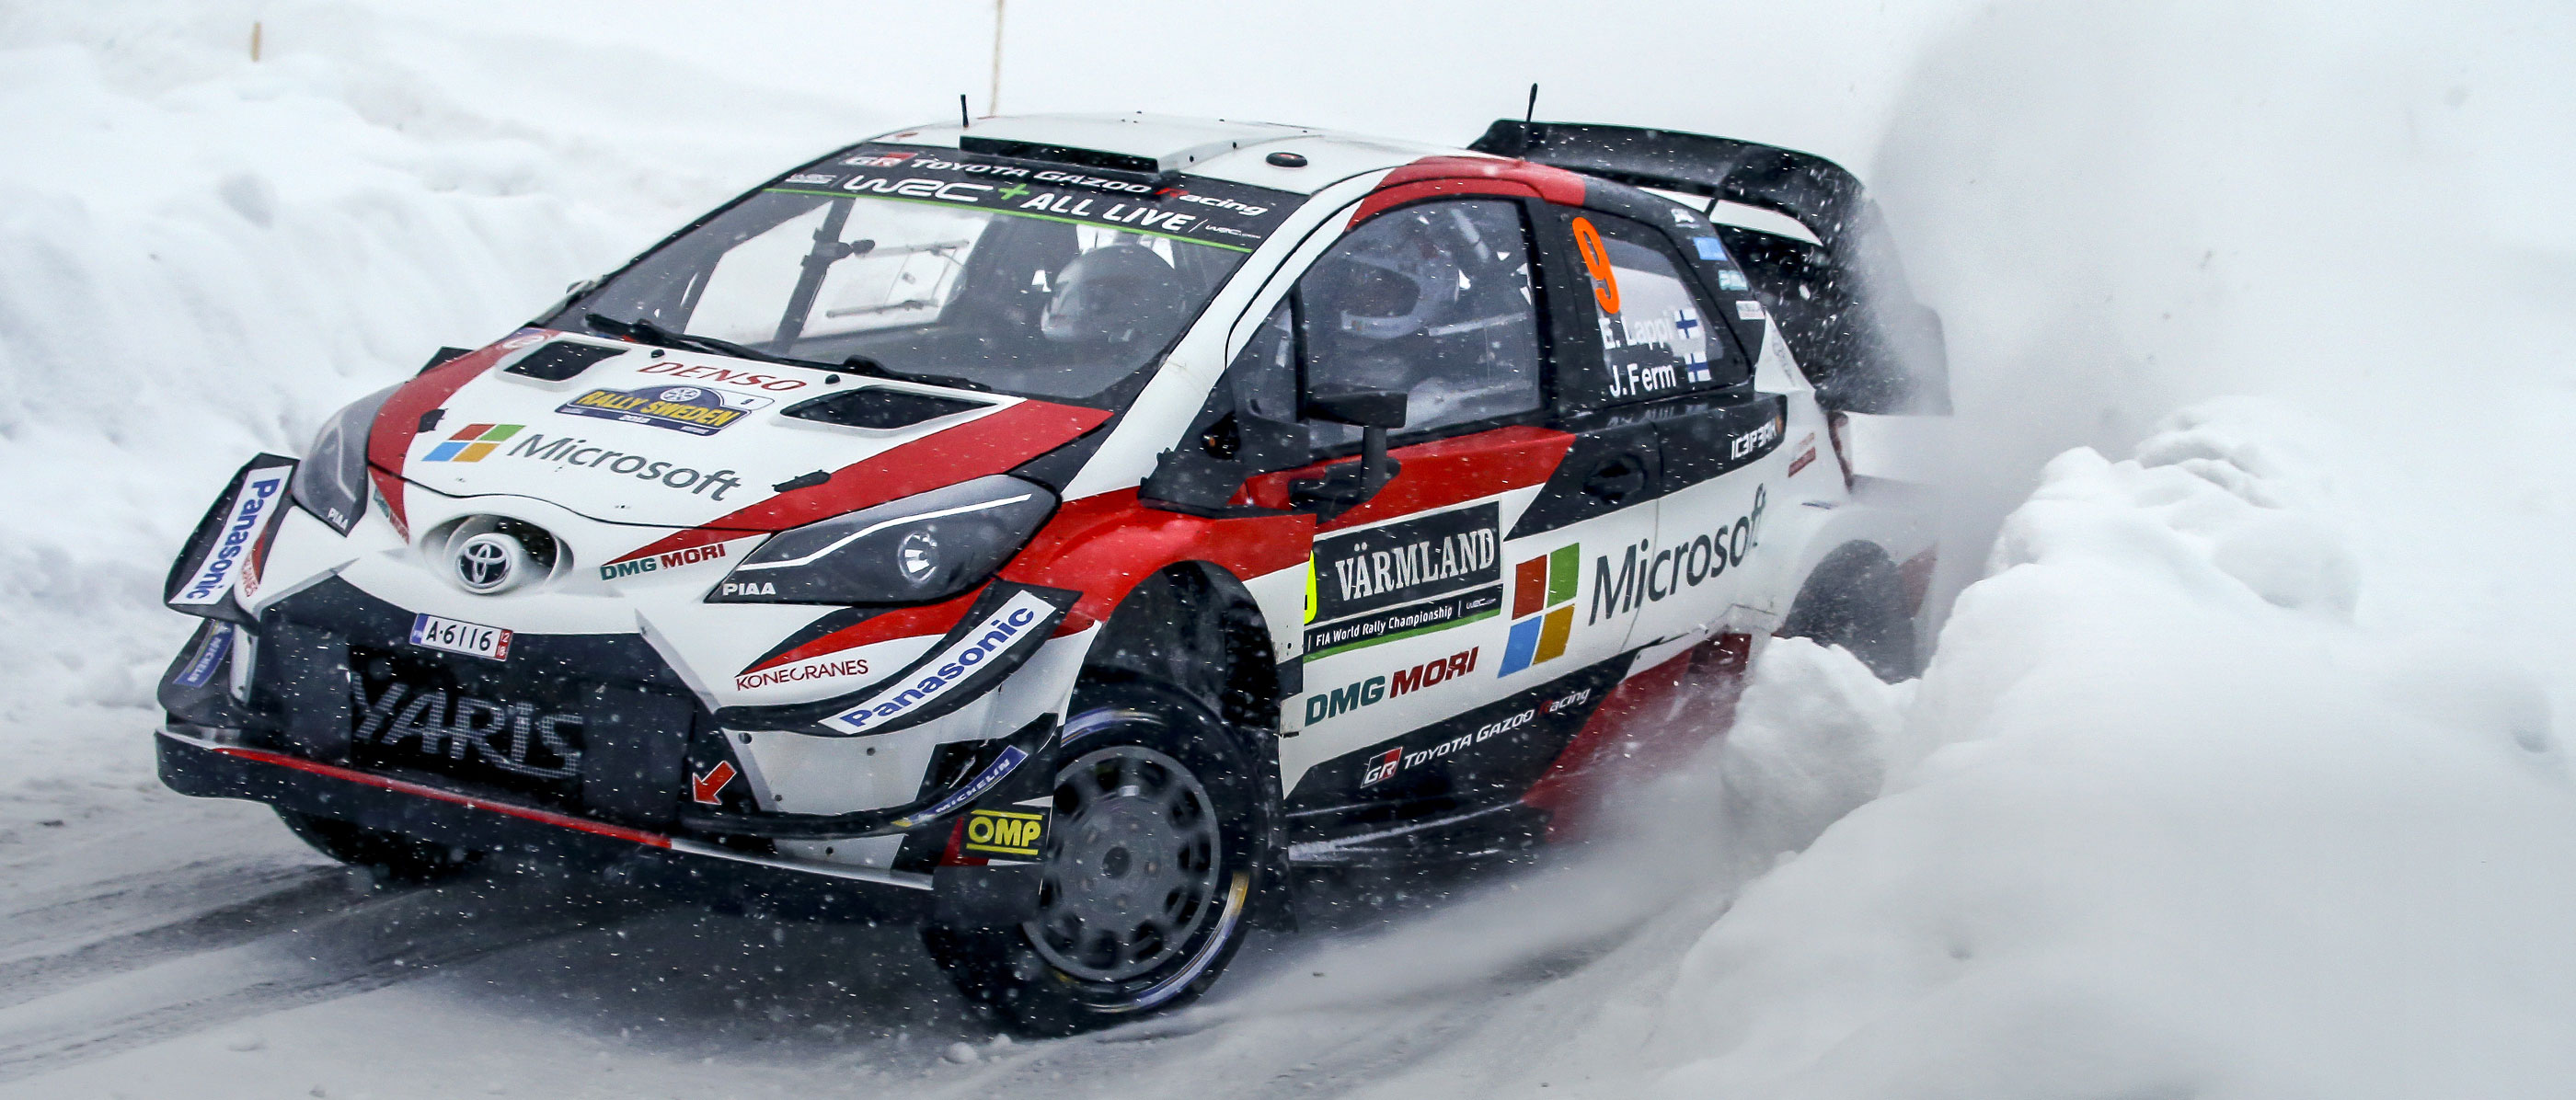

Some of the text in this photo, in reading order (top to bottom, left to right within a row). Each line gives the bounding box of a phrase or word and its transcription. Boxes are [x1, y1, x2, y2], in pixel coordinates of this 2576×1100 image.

[844, 155, 1269, 216] GR TOYOTA GAZOO Racing
[1020, 192, 1093, 217] ALL
[1102, 203, 1196, 232] LIVE
[1572, 217, 1621, 314] 9
[1598, 311, 1673, 350] E. Lappi
[637, 361, 807, 391] DENSO
[575, 391, 742, 427] RALLY SWEDEN
[507, 433, 742, 501] Microsoft
[186, 478, 281, 599] Panasonic
[600, 543, 727, 580] DMG MORI
[1335, 527, 1495, 601] VÄRMLAND
[1588, 483, 1766, 626] Microsoft
[722, 582, 776, 597] PIAA
[1316, 604, 1453, 647] FIA World Rally Championship
[736, 659, 868, 691] KONECRANES
[839, 608, 1034, 728] Panasonic
[1305, 646, 1479, 728] DMG MORI
[350, 672, 584, 779] YARIS
[1404, 734, 1472, 770] TOYOTA
[1476, 709, 1535, 743] GAZOO
[1538, 688, 1591, 716] Racing
[936, 758, 1010, 813] MICHELIN
[968, 816, 1041, 847] OMP
